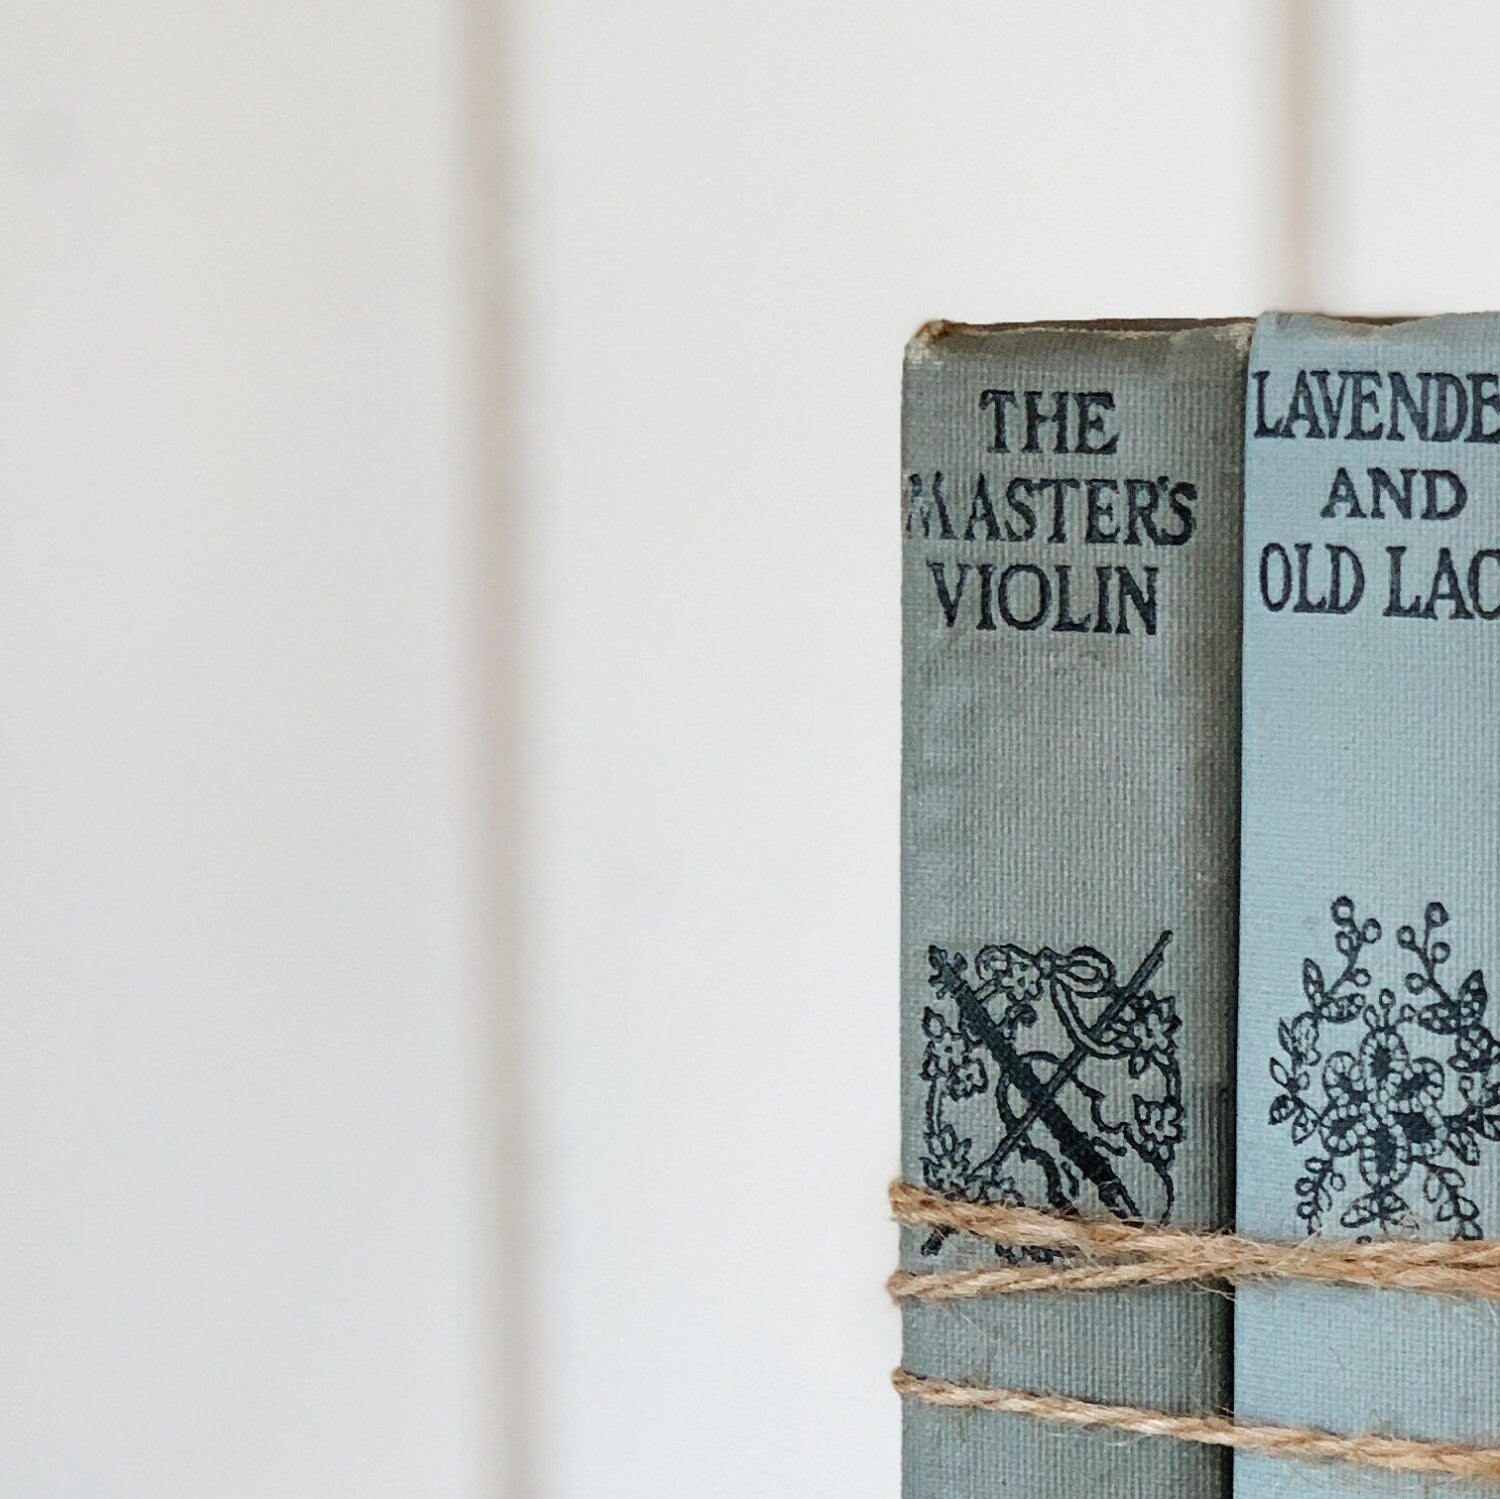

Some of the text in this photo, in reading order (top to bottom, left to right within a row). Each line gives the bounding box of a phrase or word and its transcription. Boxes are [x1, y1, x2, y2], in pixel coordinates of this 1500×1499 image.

[980, 389, 1120, 455] THE
[904, 470, 1197, 546] MASTER'S
[1320, 467, 1468, 521] AND
[926, 562, 1159, 636] VIOLIN
[1259, 543, 1365, 615] OLD
